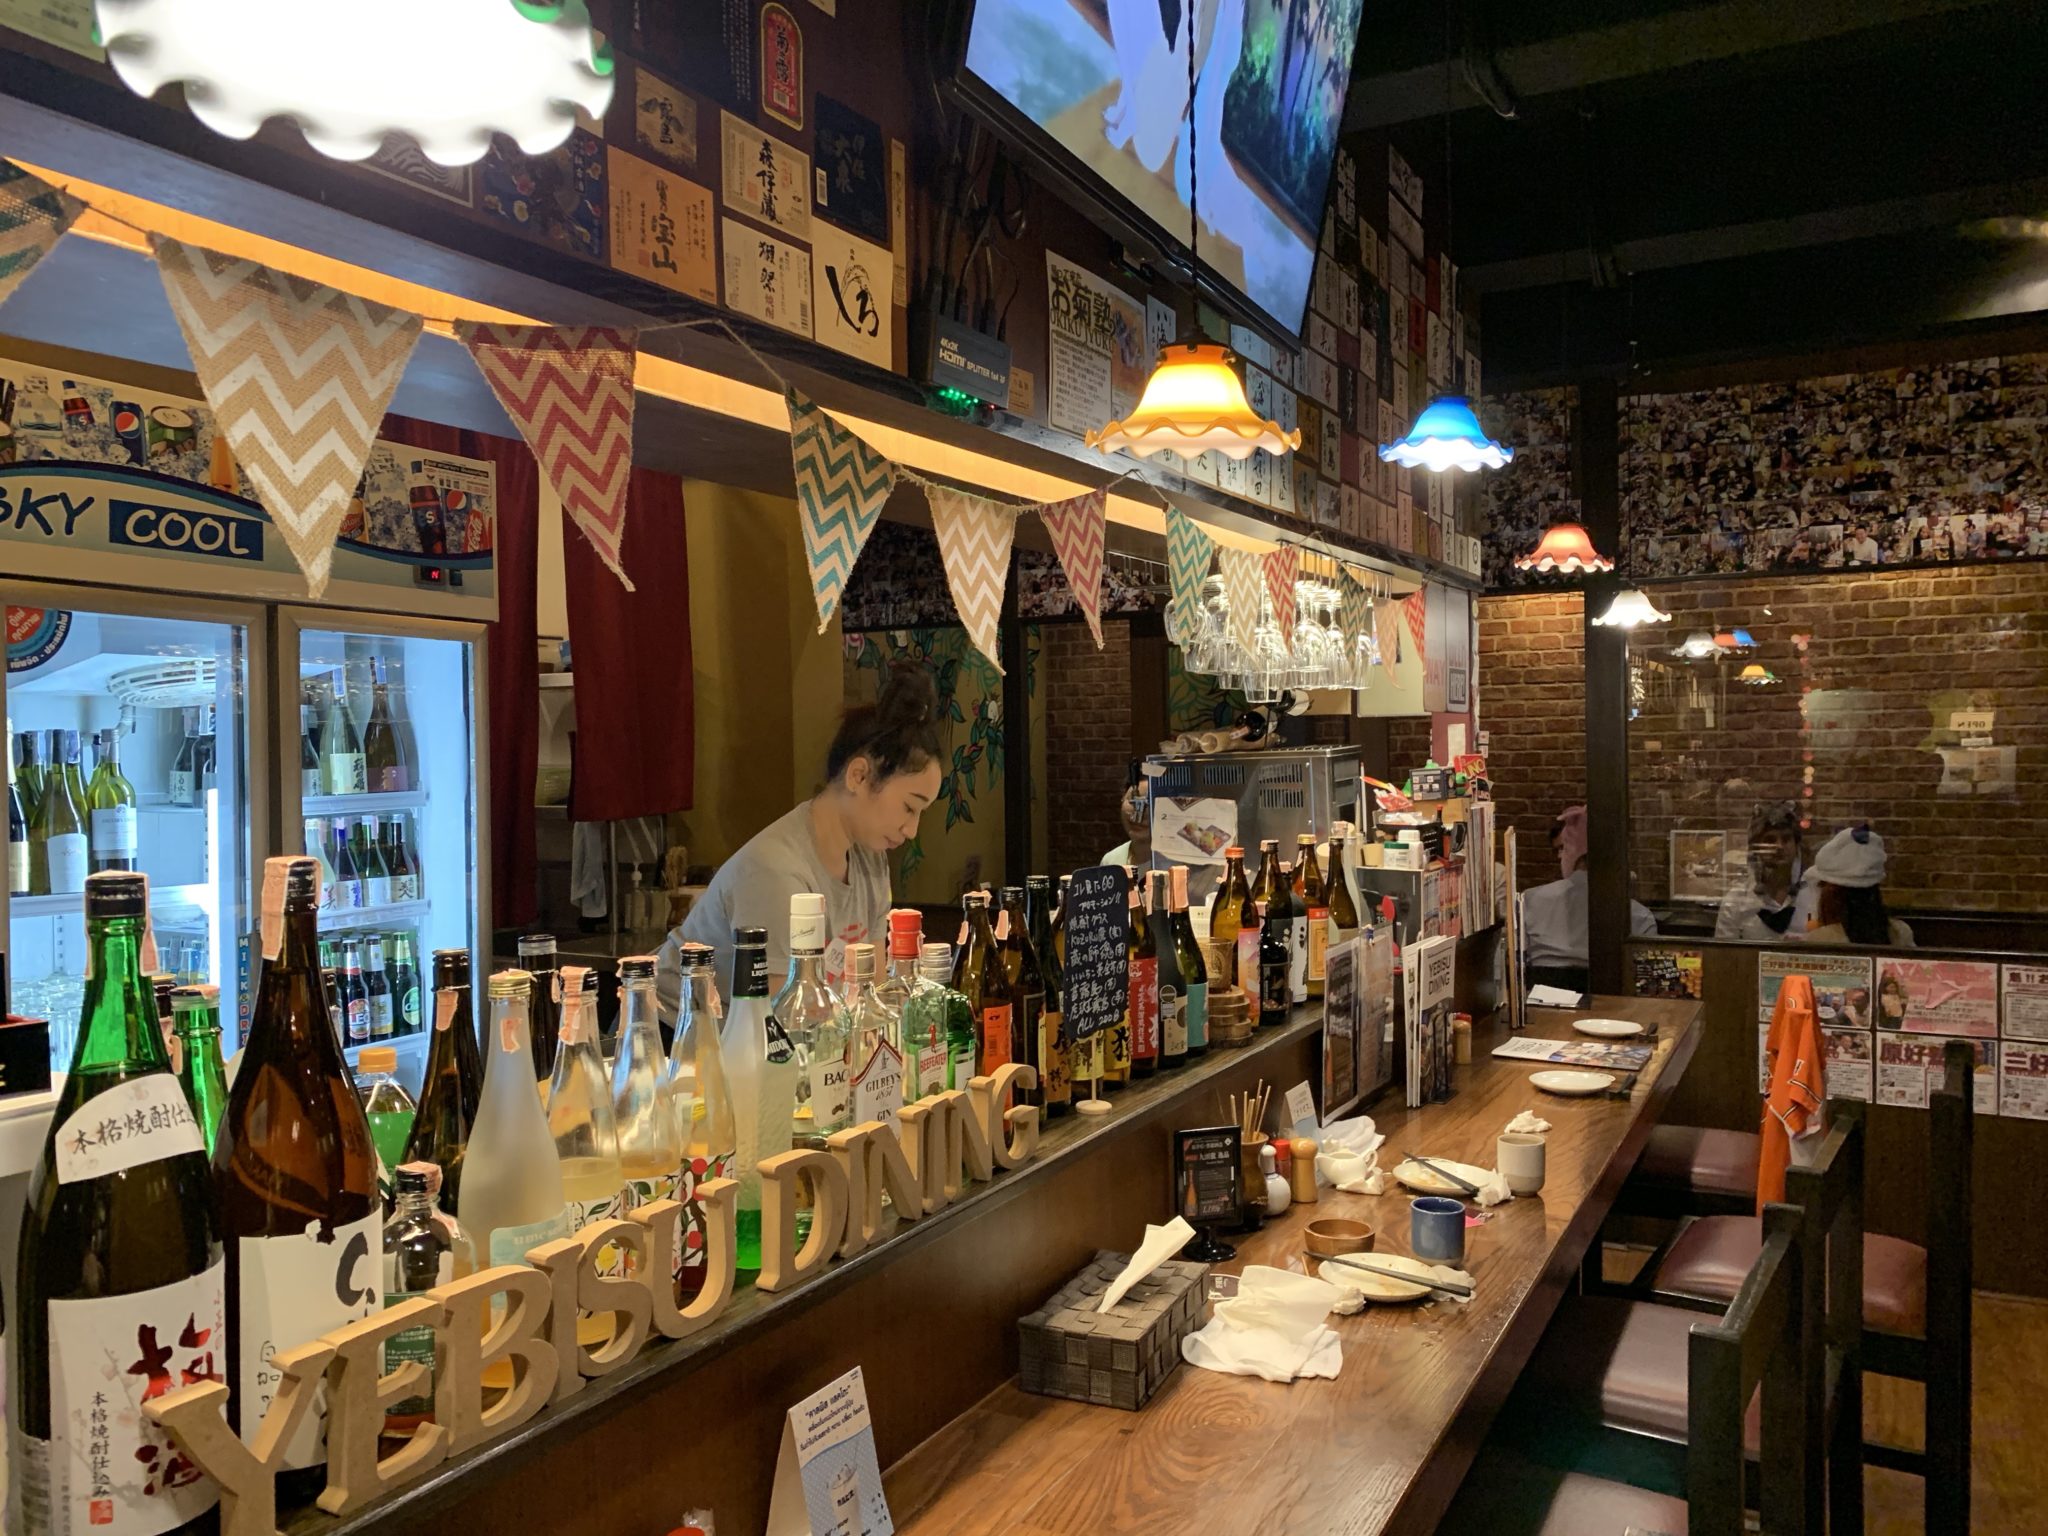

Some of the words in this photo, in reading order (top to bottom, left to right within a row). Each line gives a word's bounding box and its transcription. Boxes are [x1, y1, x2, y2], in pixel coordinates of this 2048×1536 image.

[938, 347, 966, 368] HDMI
[125, 509, 250, 557] COOL
[1463, 758, 1486, 778] UNO
[1429, 955, 1452, 978] YEBISU
[920, 1052, 947, 1074] BEEFEATER
[877, 1108, 892, 1121] GIN
[145, 1178, 739, 1536] YEBISU
[757, 1064, 1040, 1293] DINING
[89, 1392, 111, 1499] 本格焼酎仕込み
